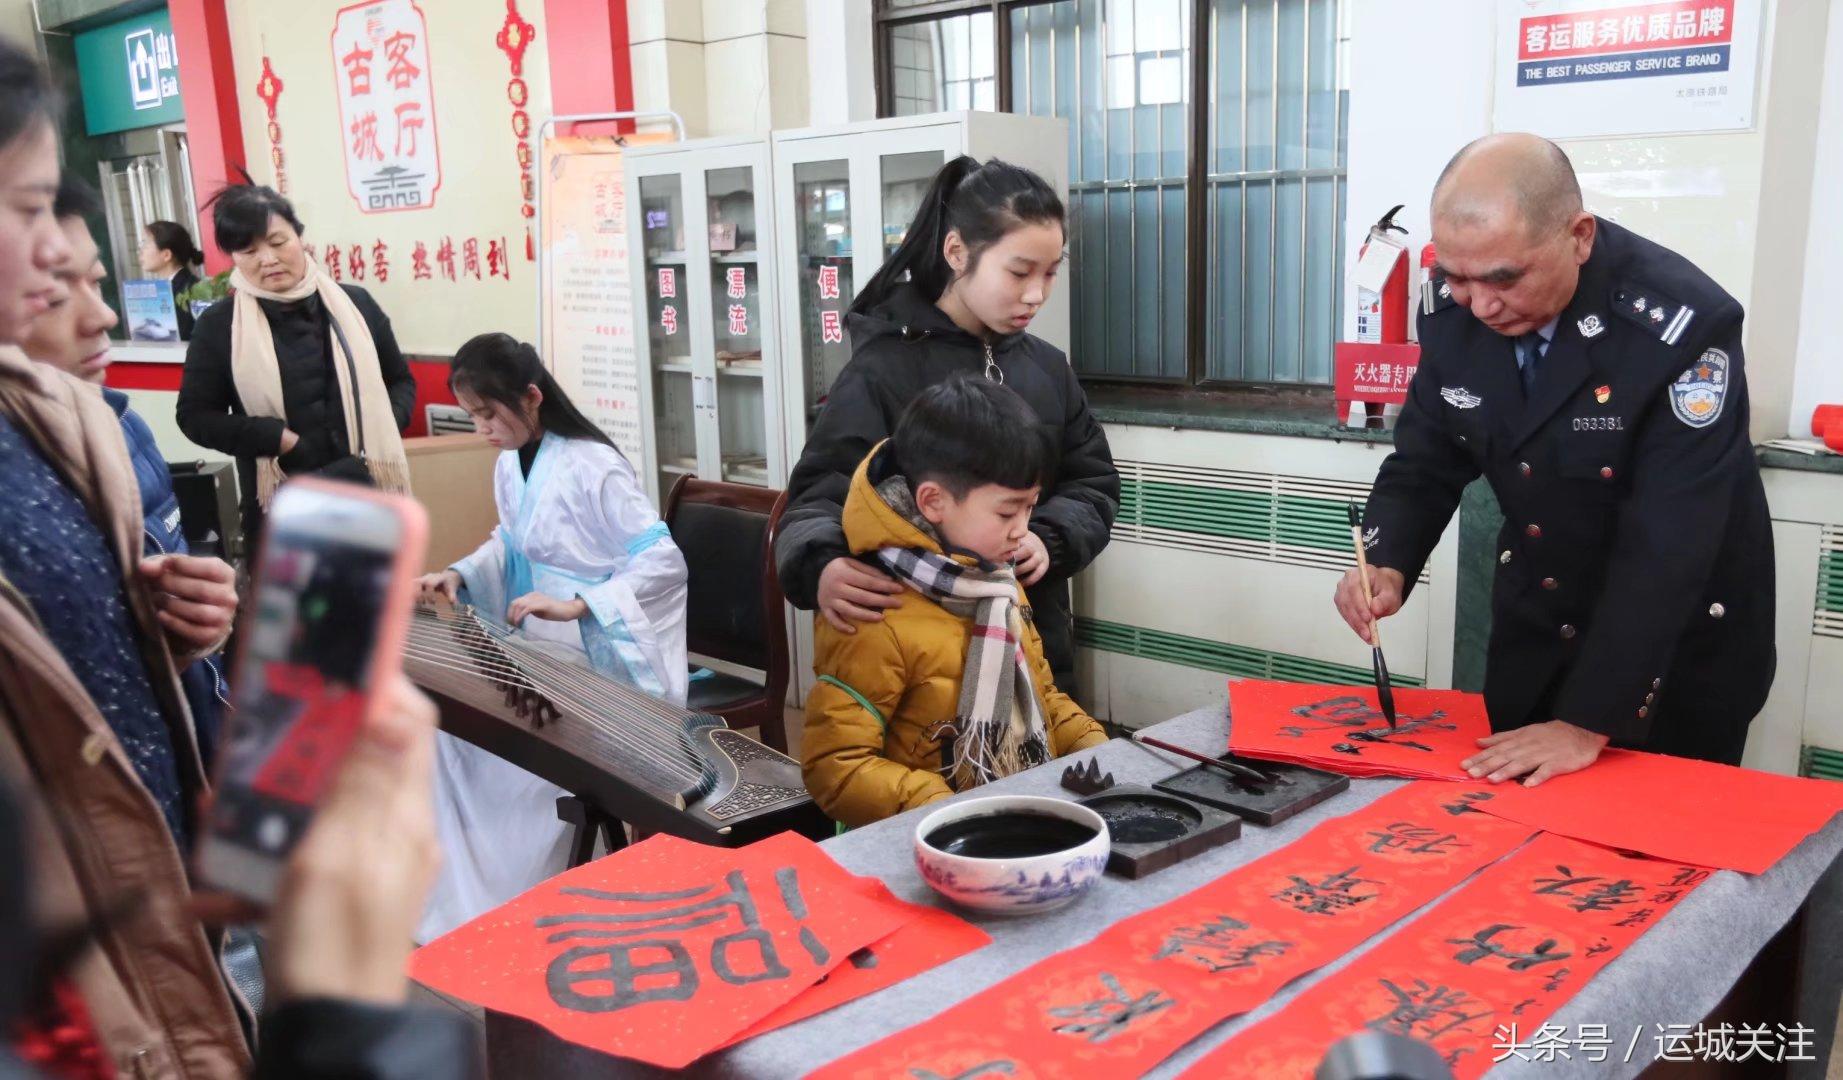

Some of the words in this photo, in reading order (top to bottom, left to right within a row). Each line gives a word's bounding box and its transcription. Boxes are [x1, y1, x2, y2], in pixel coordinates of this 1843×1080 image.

[1525, 7, 1725, 53] 客运服务优质品牌
[1525, 68, 1543, 80] THE
[1547, 65, 1571, 77] BEST
[1575, 60, 1631, 76] PASSENGER
[1635, 56, 1681, 71] SERVICE
[1685, 53, 1721, 67] BRAND
[304, 238, 390, 283] 信好客
[411, 234, 510, 283] 热情周到
[658, 266, 678, 336] 图书
[726, 266, 748, 336] 漂流
[817, 265, 843, 344] 便民
[1573, 416, 1624, 431] 063381
[534, 867, 831, 1013] 福
